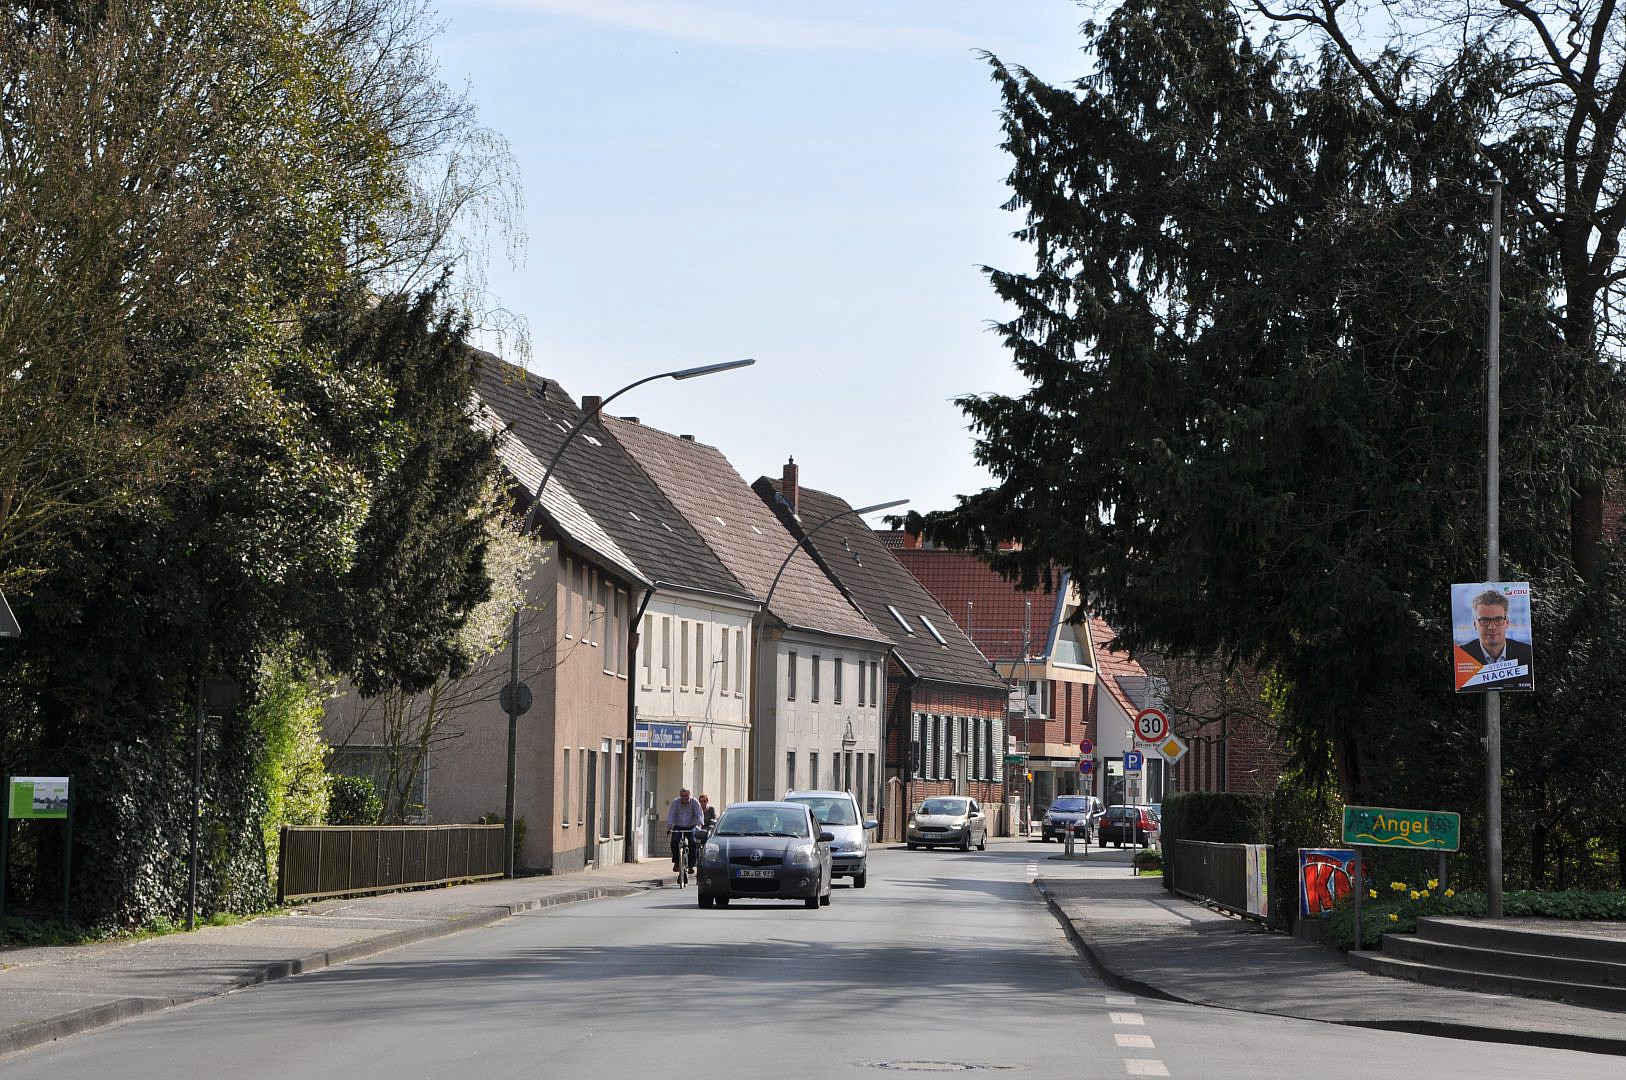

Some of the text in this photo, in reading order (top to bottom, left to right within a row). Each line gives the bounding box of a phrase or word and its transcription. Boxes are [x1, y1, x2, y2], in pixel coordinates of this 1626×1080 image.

[1488, 661, 1512, 670] STEFAN
[1482, 668, 1521, 682] NACKE
[1141, 718, 1161, 734] 30
[1128, 754, 1138, 769] P
[1372, 814, 1429, 837] Angel
